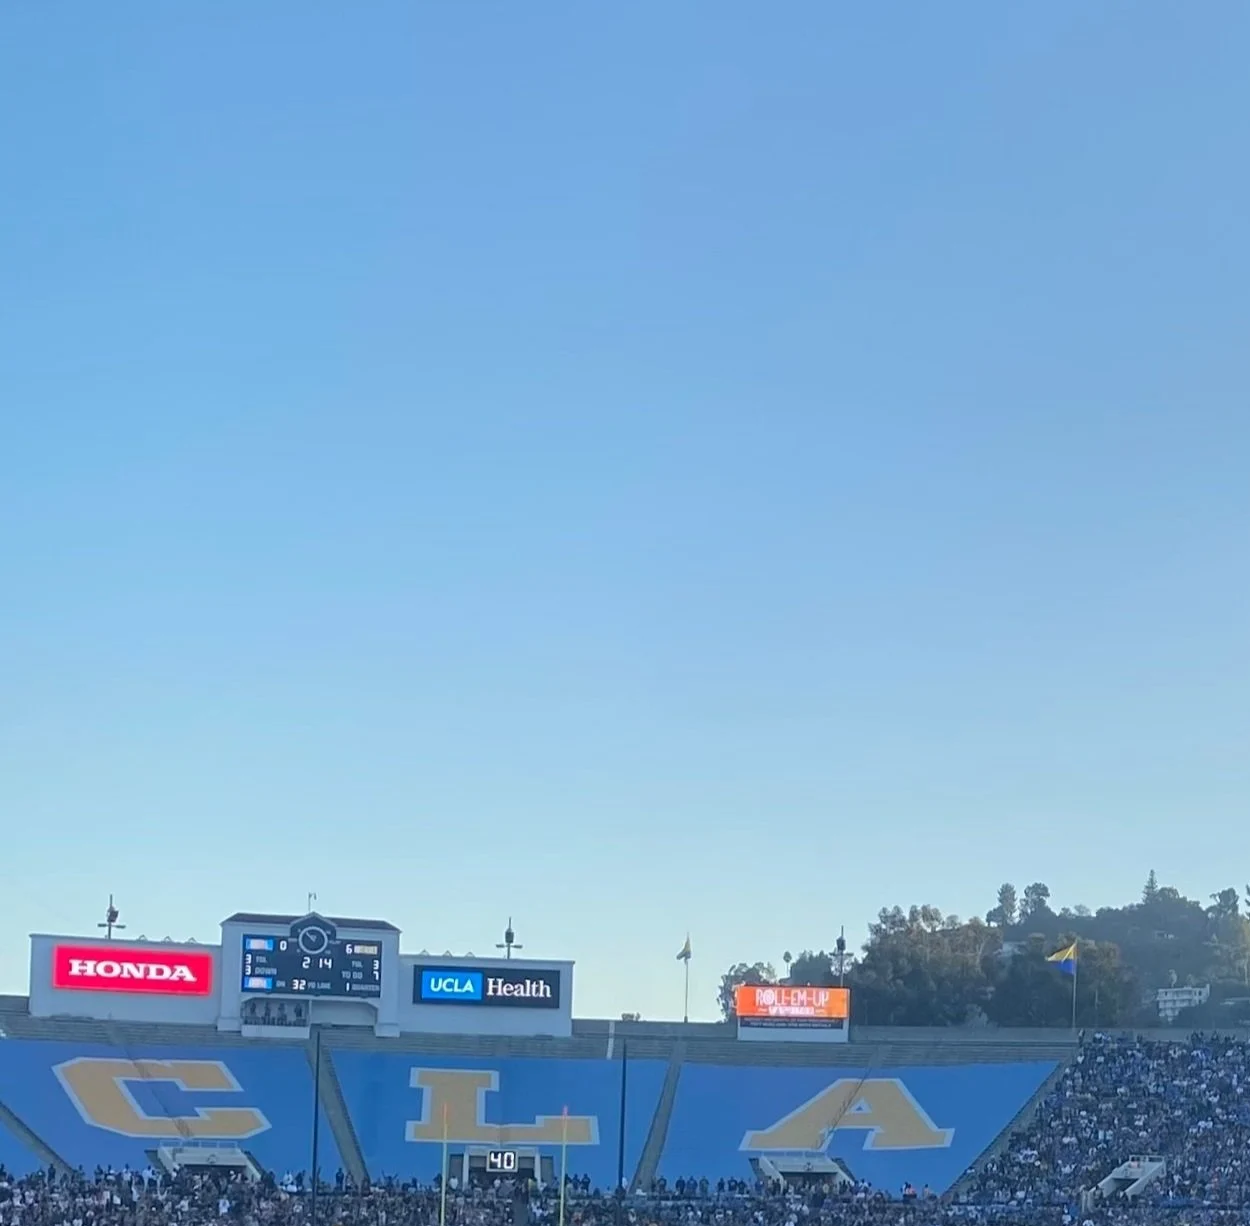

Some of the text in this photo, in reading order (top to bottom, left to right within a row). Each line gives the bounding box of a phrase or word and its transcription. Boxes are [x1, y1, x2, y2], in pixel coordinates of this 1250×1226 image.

[245, 954, 252, 964] 3
[69, 959, 197, 982] HONDA
[245, 965, 252, 975] 3
[292, 980, 306, 990] 32
[430, 977, 552, 998] UCLA Health
[491, 1152, 514, 1169] 40
